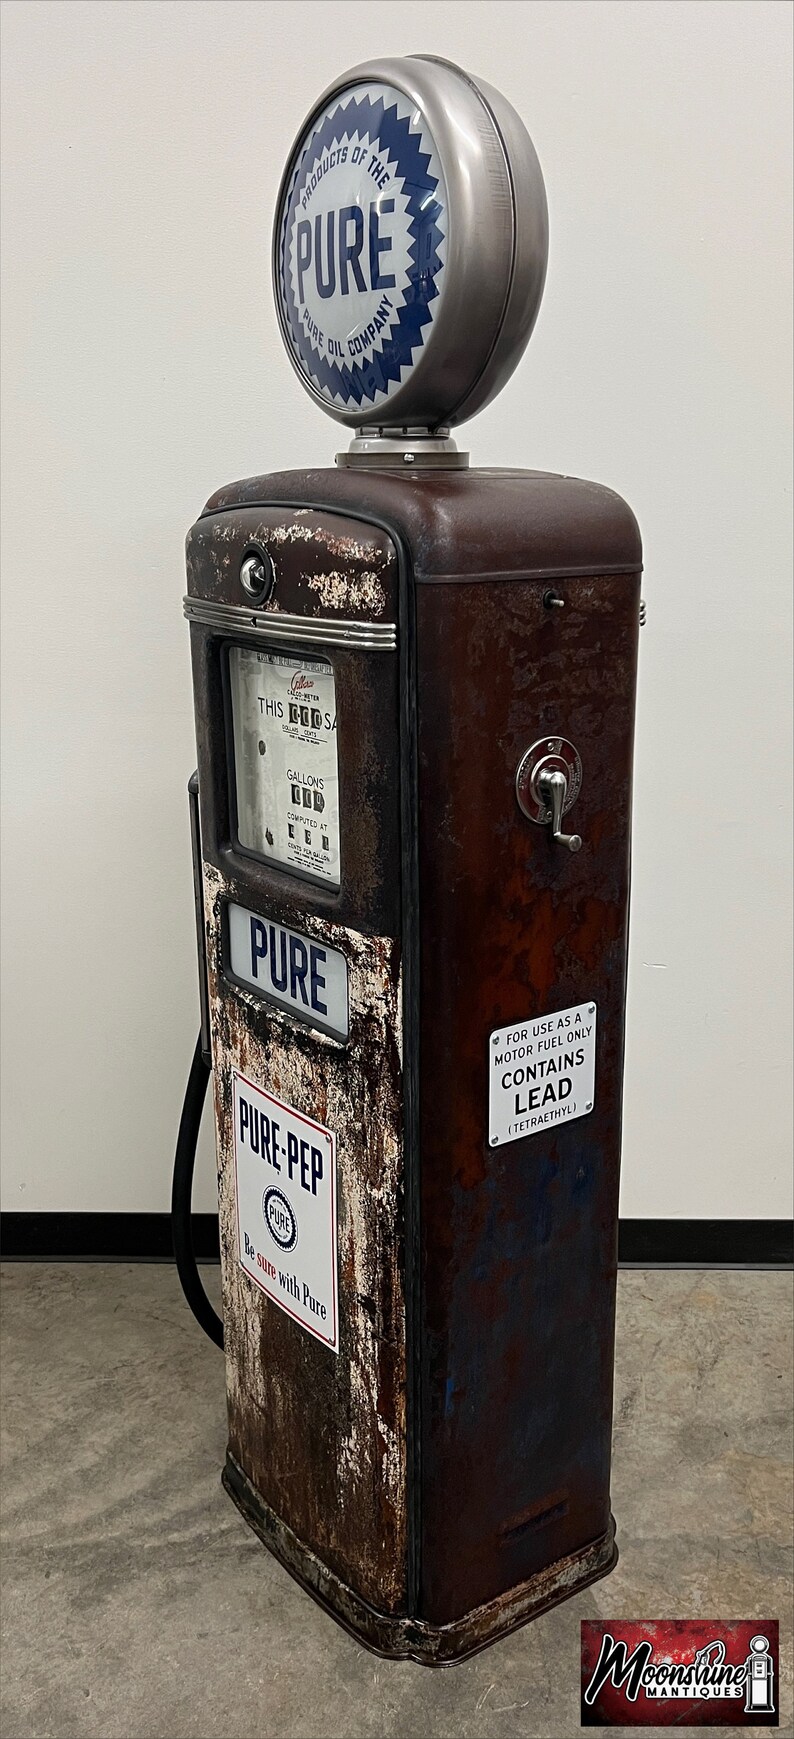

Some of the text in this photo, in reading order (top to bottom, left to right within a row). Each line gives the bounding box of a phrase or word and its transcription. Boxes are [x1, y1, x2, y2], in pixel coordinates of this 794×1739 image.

[301, 146, 391, 210] PRODUCTS OF THE
[297, 198, 396, 304] PURE
[303, 294, 395, 358] PURE OIL COMPANY
[258, 697, 284, 718] THIS
[304, 729, 317, 738] CENTS
[286, 769, 324, 790] GALLONS
[287, 812, 328, 831] COMPUTED AT
[250, 916, 328, 1016] PURE
[494, 1026, 593, 1066] MOTOR FUEL ONLY
[506, 1013, 582, 1045] FOR USE AS A
[501, 1049, 585, 1090] CONTAINS
[515, 1077, 572, 1116] LEAD
[239, 1096, 323, 1196] PURE-PEP
[270, 1204, 290, 1234] PURE
[244, 1232, 327, 1320] Be sure with Pure
